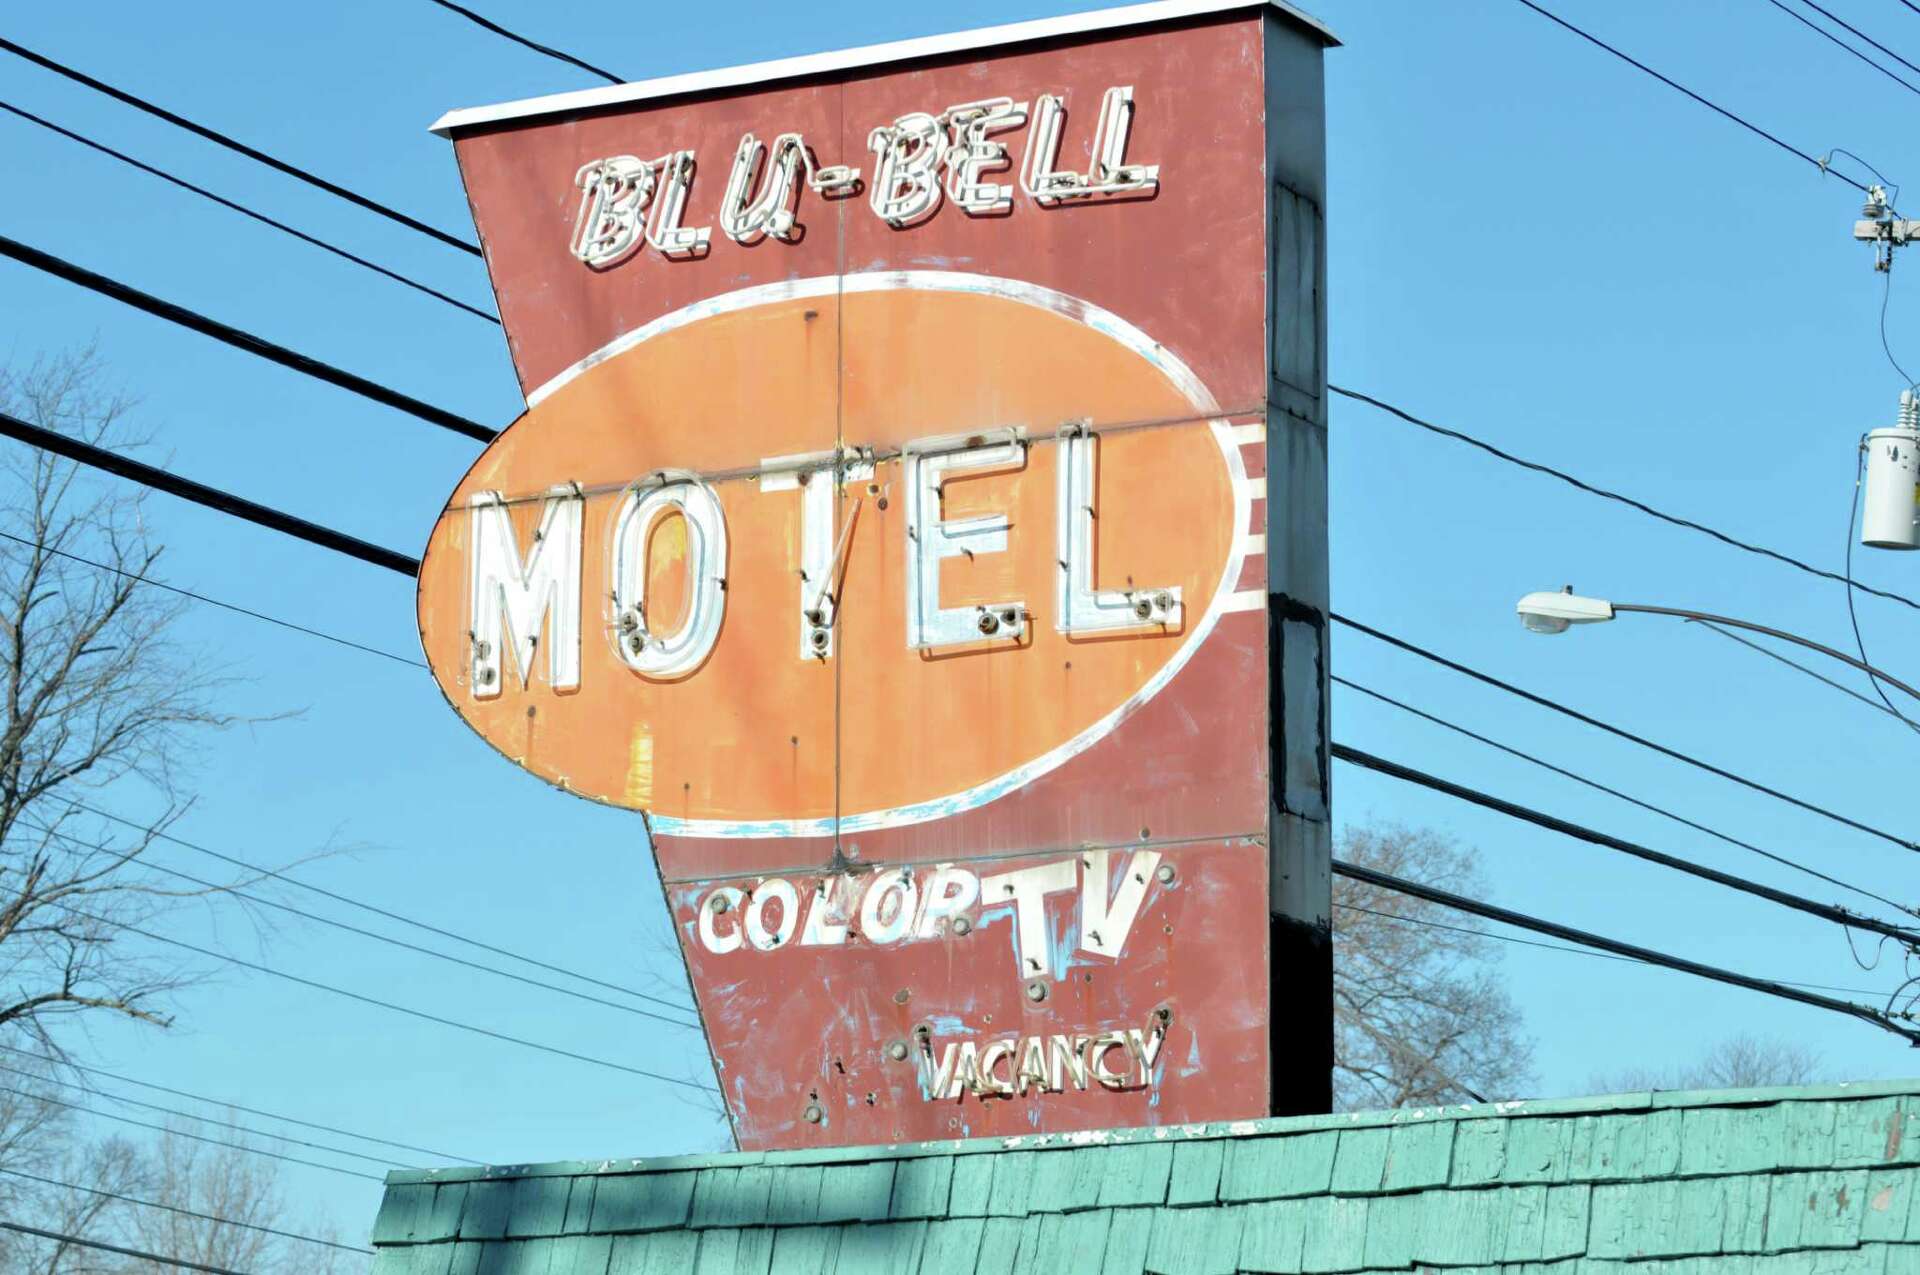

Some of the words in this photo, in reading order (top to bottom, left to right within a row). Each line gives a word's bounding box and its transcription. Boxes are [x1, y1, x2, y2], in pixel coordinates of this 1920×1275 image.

[569, 85, 1160, 268] BLU-BELL
[468, 421, 1184, 698] MOTEL
[981, 848, 1161, 979] TV
[922, 1028, 1164, 1101] VACANCY
